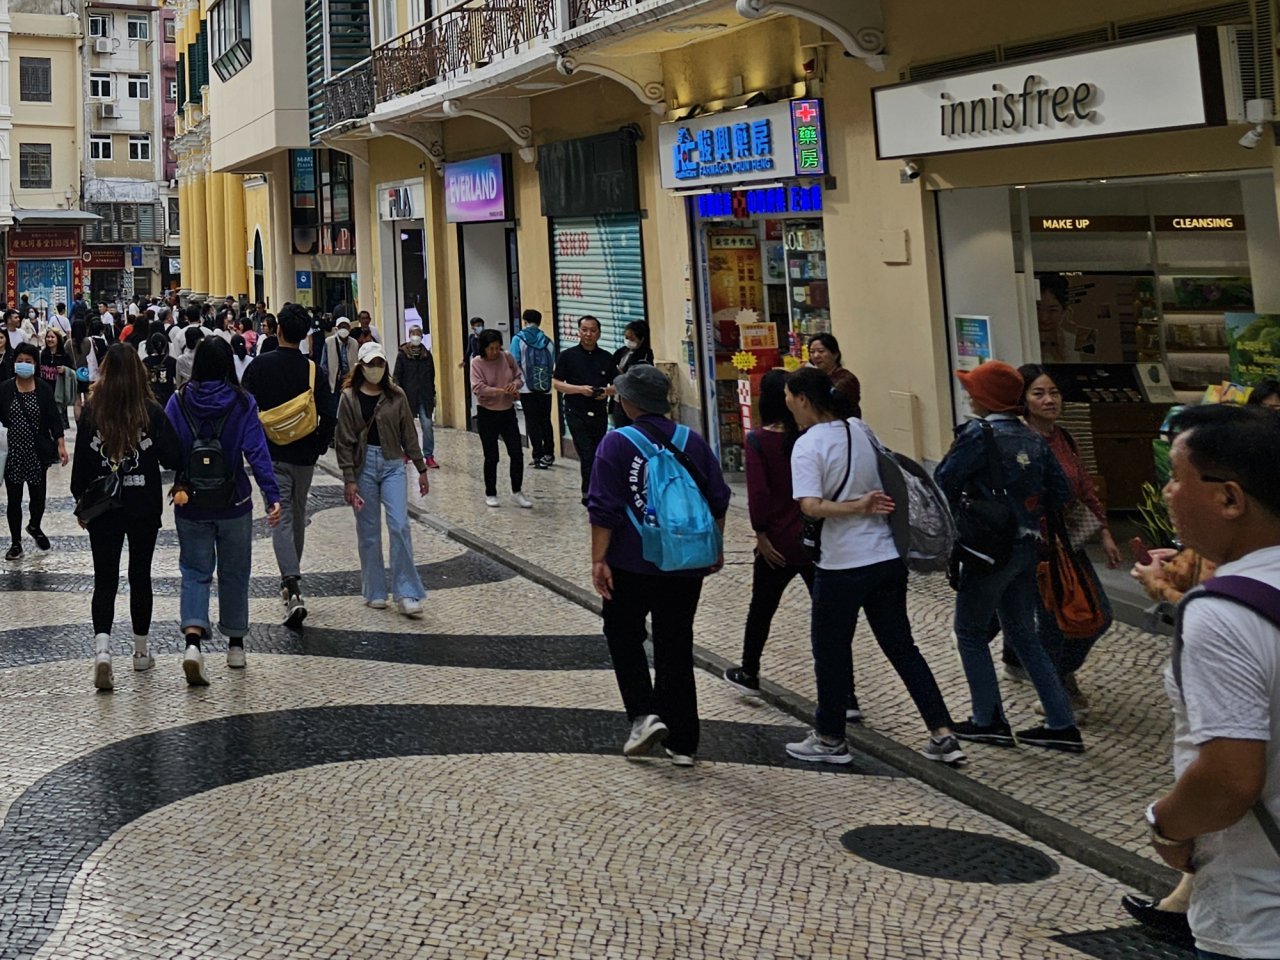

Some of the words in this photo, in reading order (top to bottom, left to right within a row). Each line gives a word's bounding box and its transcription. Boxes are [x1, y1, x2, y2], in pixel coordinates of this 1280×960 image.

[940, 74, 1091, 136] innisfree
[798, 125, 819, 169] 藥房
[751, 157, 773, 171] HENG
[449, 170, 497, 204] EVERLAND
[1043, 219, 1072, 229] MAKE
[1075, 219, 1090, 229] UP
[1172, 218, 1233, 228] CLEANSING
[629, 455, 644, 483] DARE
